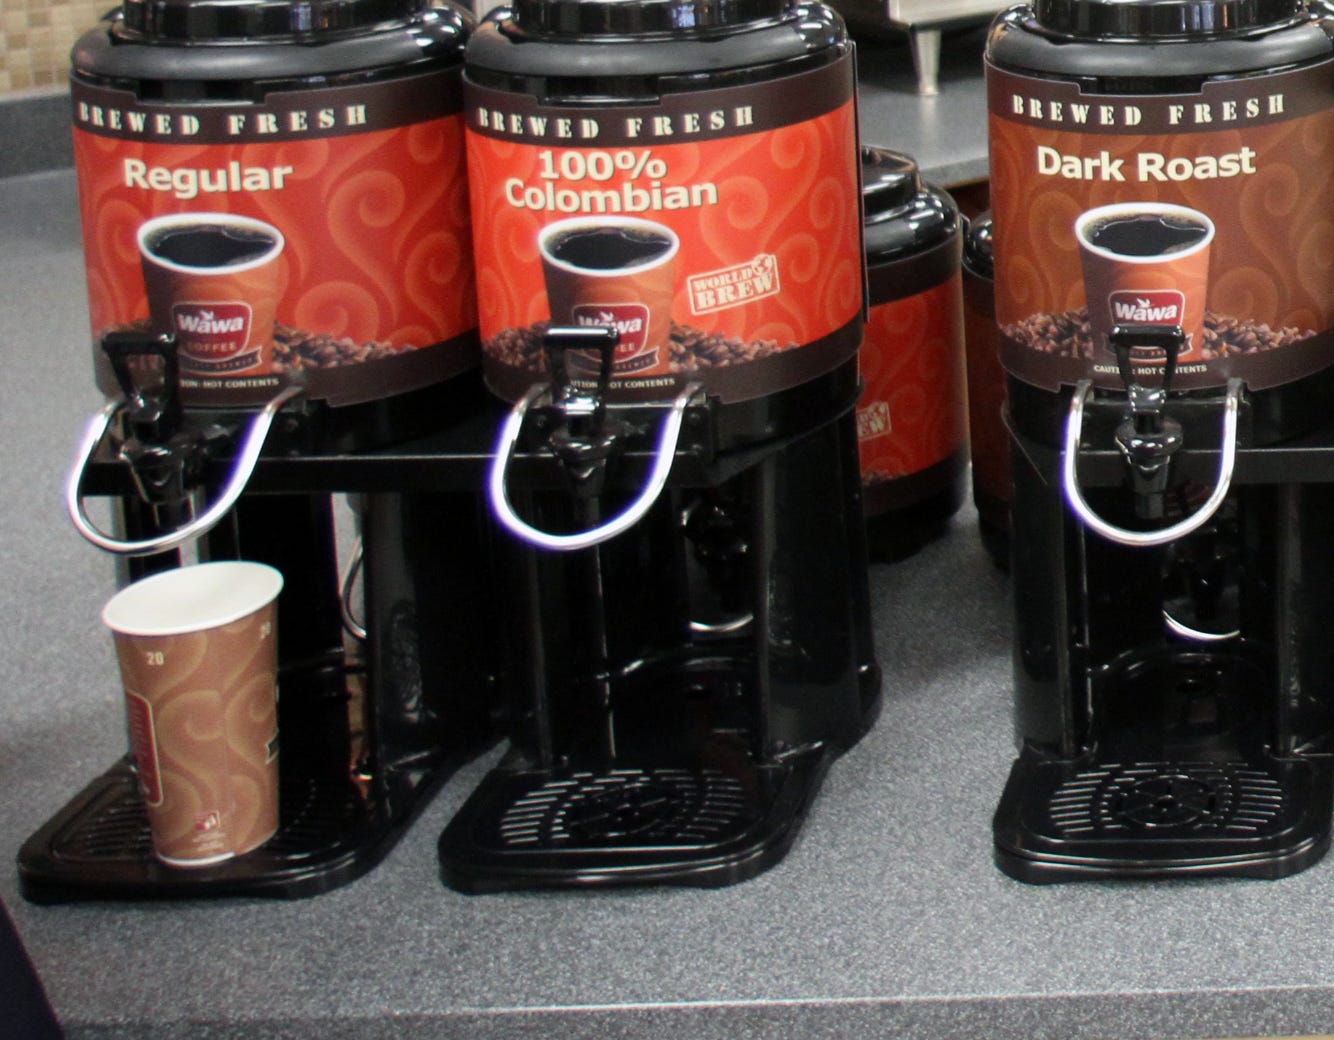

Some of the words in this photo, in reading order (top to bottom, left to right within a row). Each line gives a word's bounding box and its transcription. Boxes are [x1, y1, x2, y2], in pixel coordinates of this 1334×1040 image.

[78, 101, 200, 136] BREWED
[227, 103, 368, 136] FRESH
[477, 107, 600, 139] BREWED
[625, 105, 754, 139] FRESH
[1012, 93, 1143, 127] BREWED
[1168, 93, 1285, 125] FRESH
[123, 157, 295, 200] Regular
[538, 149, 668, 182] 100%
[1037, 145, 1126, 182] Dark
[1137, 146, 1257, 182] Roast
[504, 177, 719, 214] Colombian
[693, 267, 753, 290] WORLD
[696, 273, 774, 310] BREW
[178, 310, 245, 334] Wawa
[1115, 298, 1178, 321] Wawa
[225, 378, 279, 388] CONTENTS
[625, 378, 675, 389] CONTENTS
[1137, 367, 1156, 375] HOT
[145, 651, 165, 666] 20
